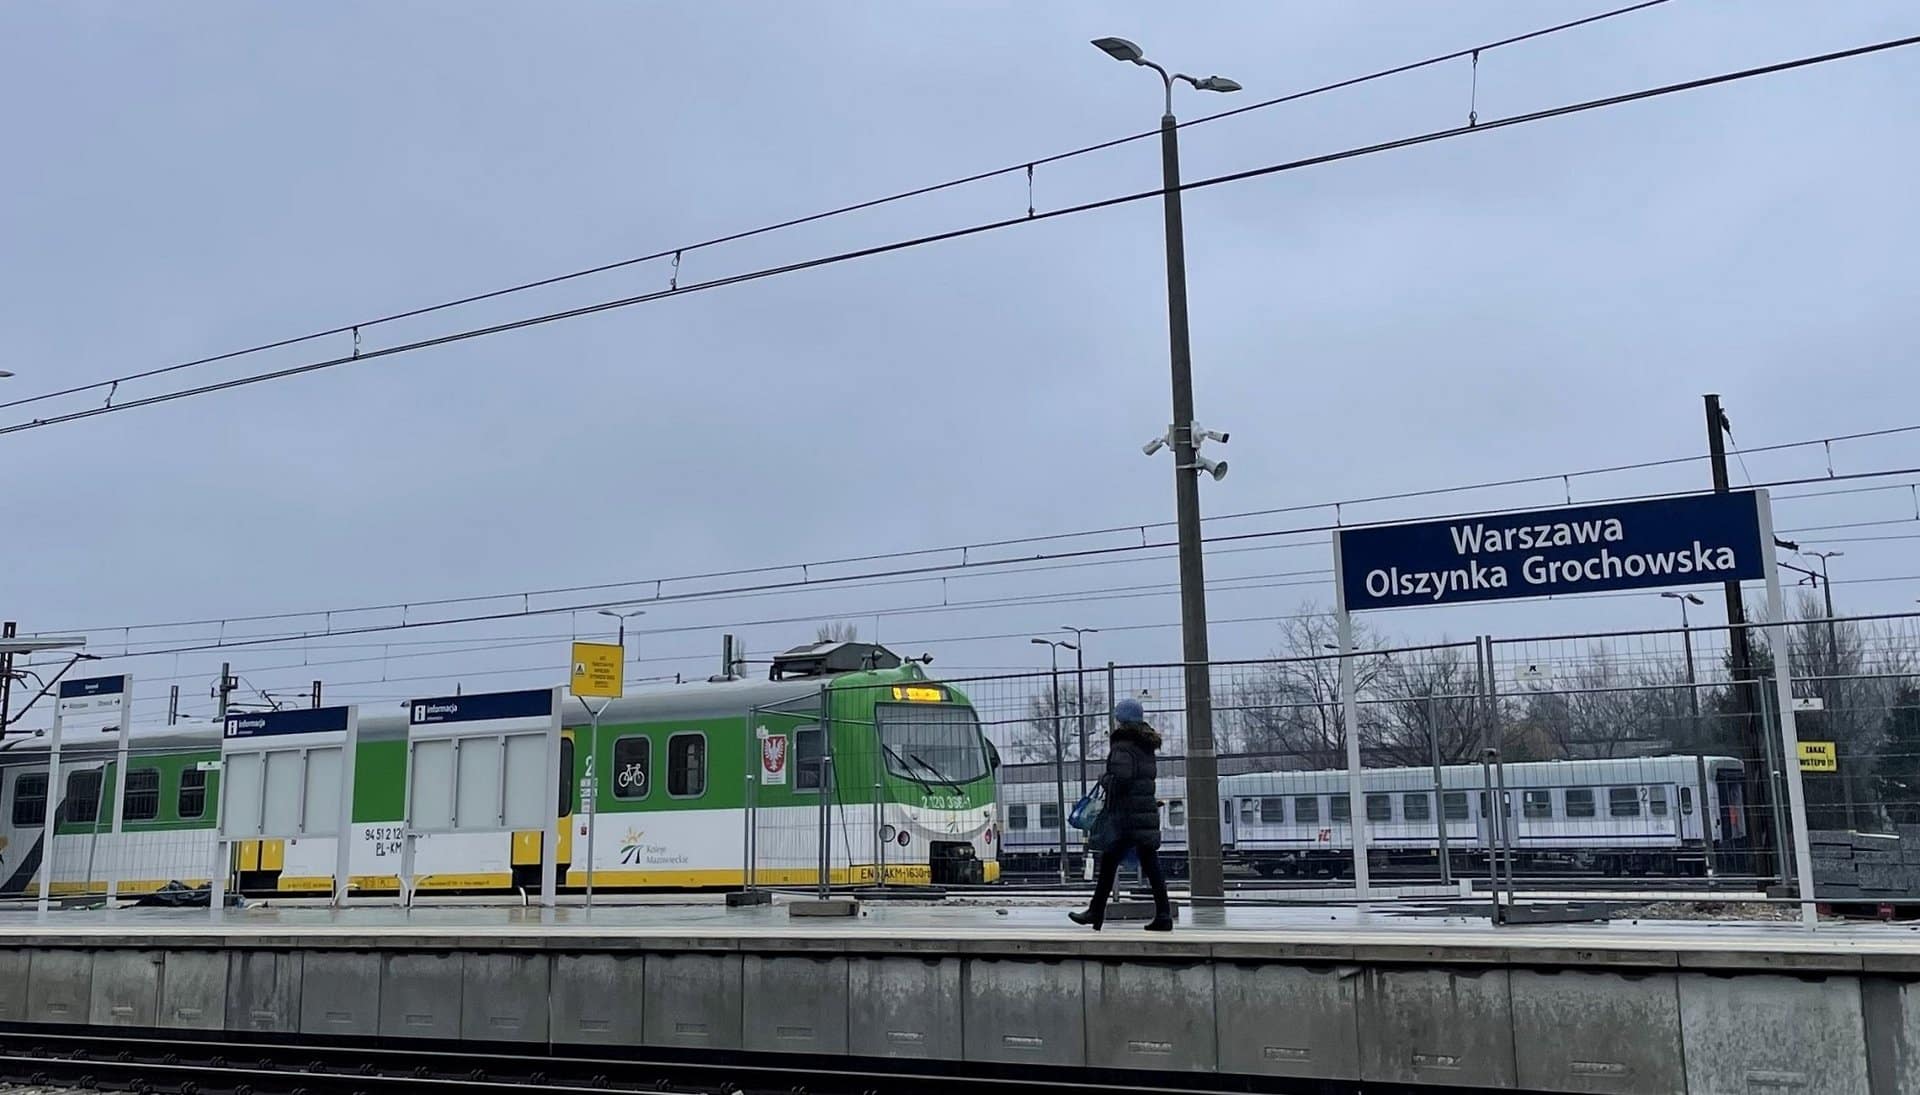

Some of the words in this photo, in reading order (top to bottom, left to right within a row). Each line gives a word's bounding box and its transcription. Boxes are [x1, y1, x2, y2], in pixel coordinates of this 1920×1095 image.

[1450, 517, 1623, 554] Warszawa
[1366, 560, 1508, 600] Olszynka
[1522, 541, 1736, 584] Grochowska
[1806, 746, 1825, 754] ZAKAZ
[585, 755, 593, 776] 2
[1640, 787, 1648, 801] 2
[1254, 799, 1260, 812] 2
[386, 828, 391, 840] 2
